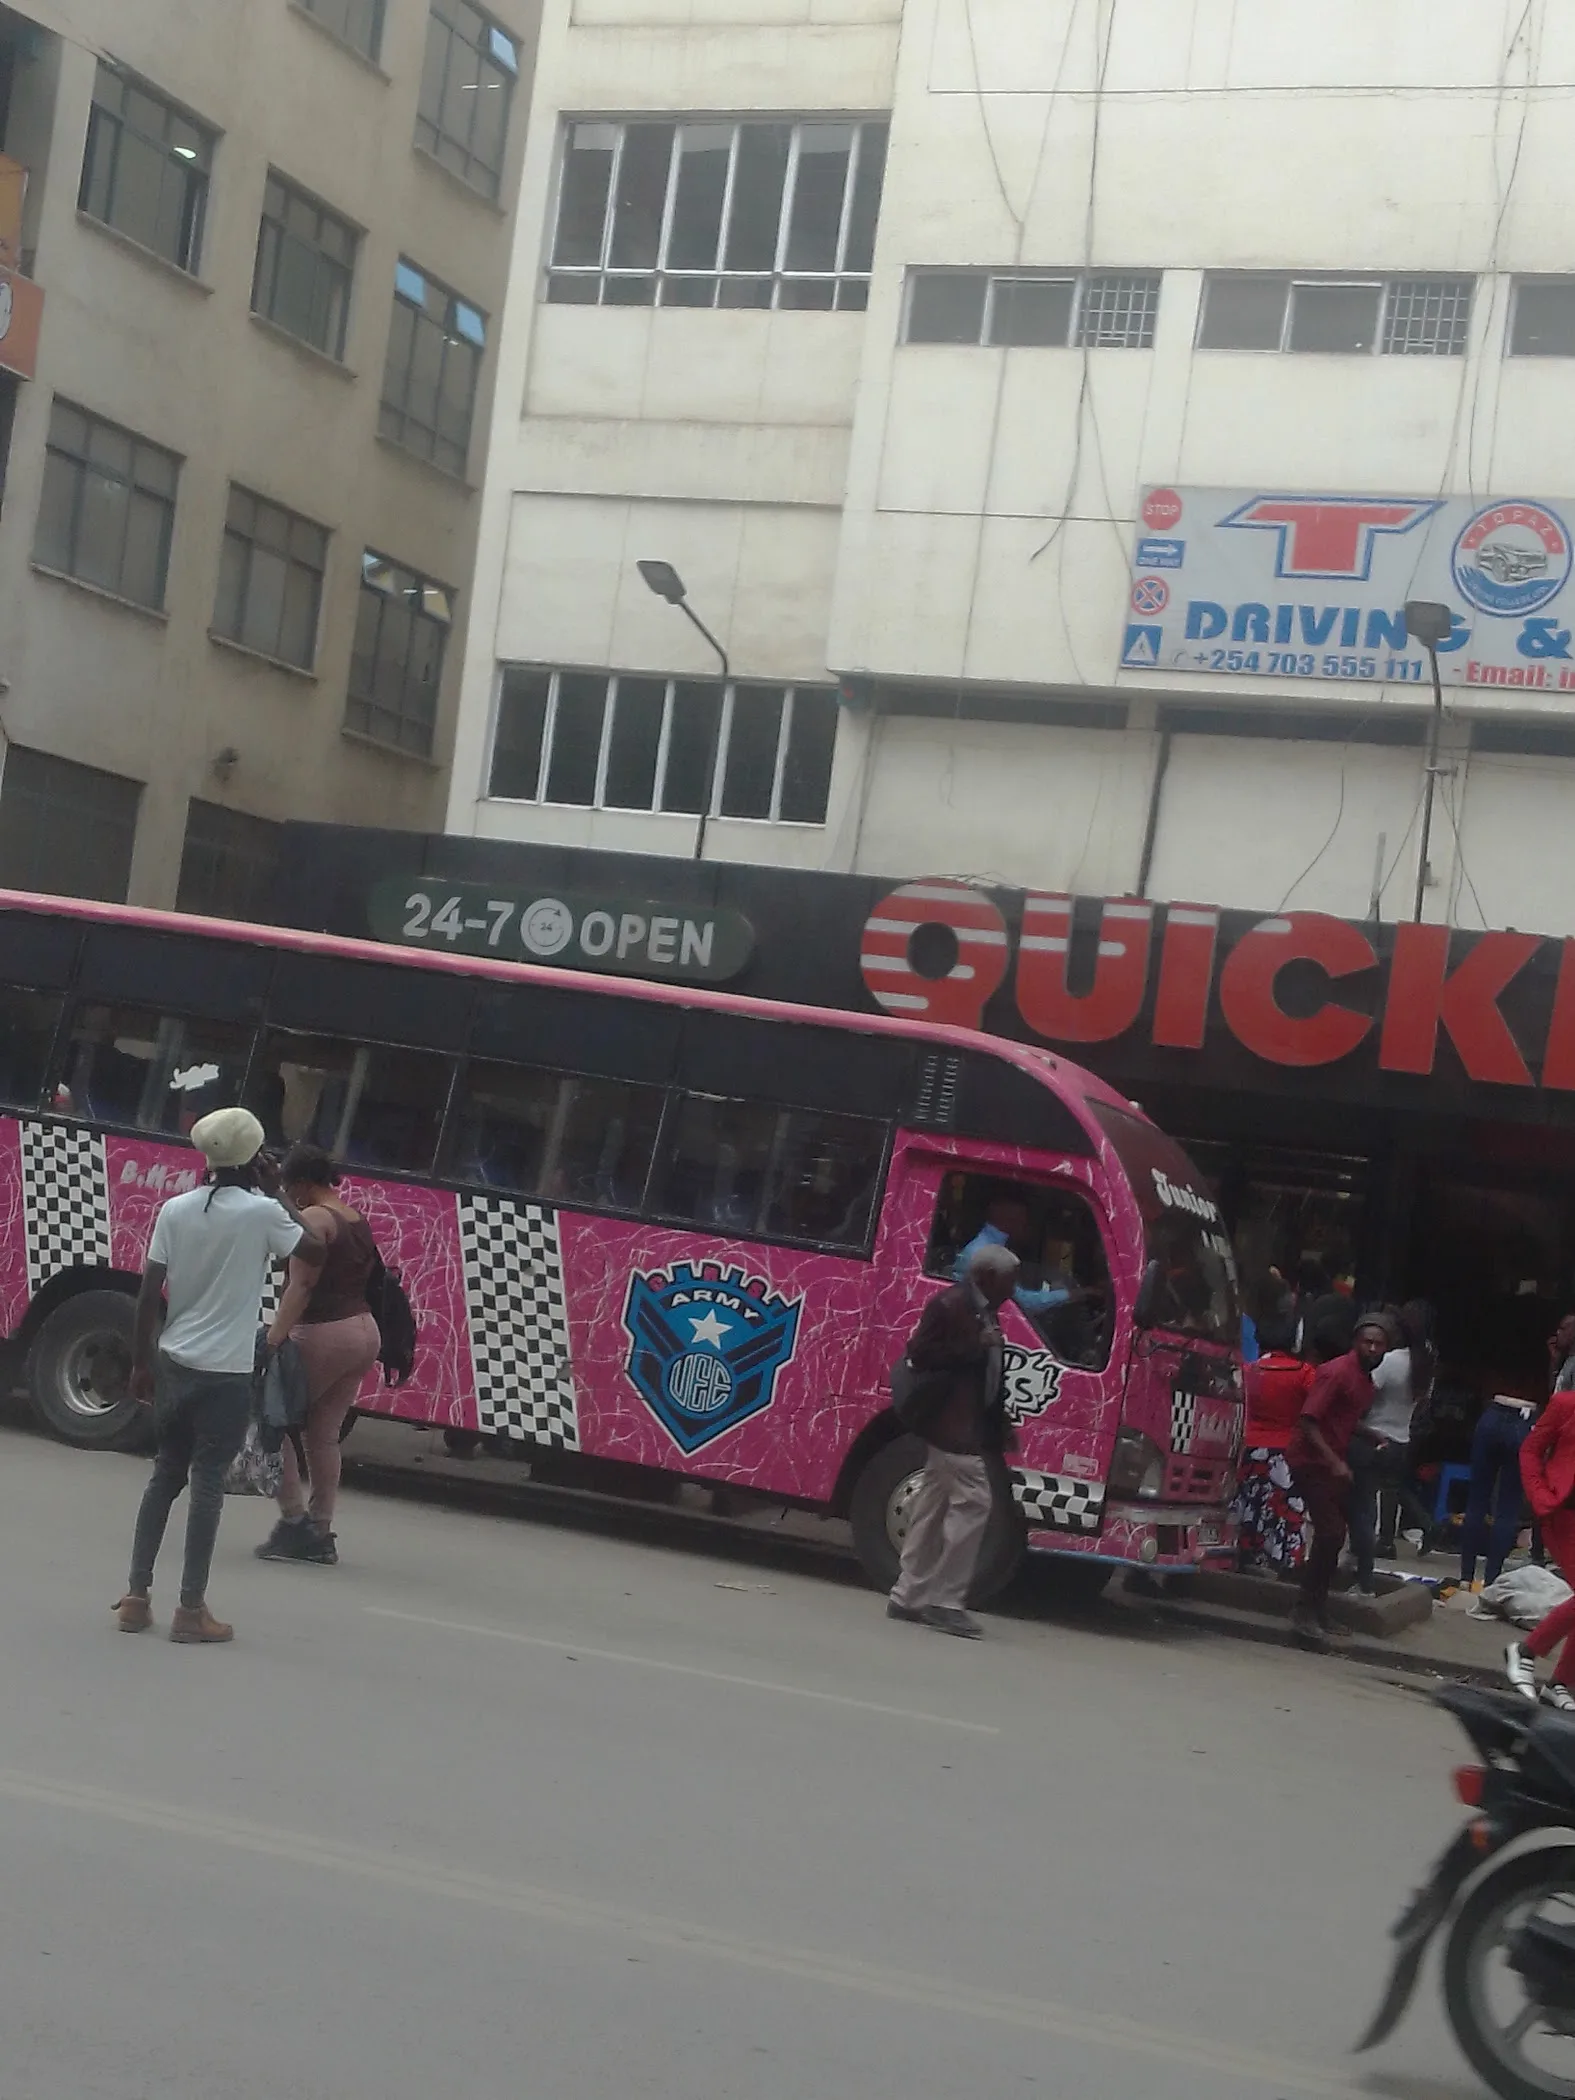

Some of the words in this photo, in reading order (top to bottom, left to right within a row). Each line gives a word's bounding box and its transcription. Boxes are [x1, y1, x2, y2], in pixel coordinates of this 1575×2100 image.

[1145, 504, 1179, 516] STOP
[1516, 617, 1573, 660] &
[1193, 650, 1260, 673] +254
[1268, 652, 1315, 676] 703
[1322, 655, 1376, 679] 555
[1384, 658, 1422, 681] 111
[1465, 661, 1553, 688] Email:
[402, 893, 515, 947] 24-7
[579, 911, 715, 966] OPEN
[671, 1289, 760, 1319] ARMY
